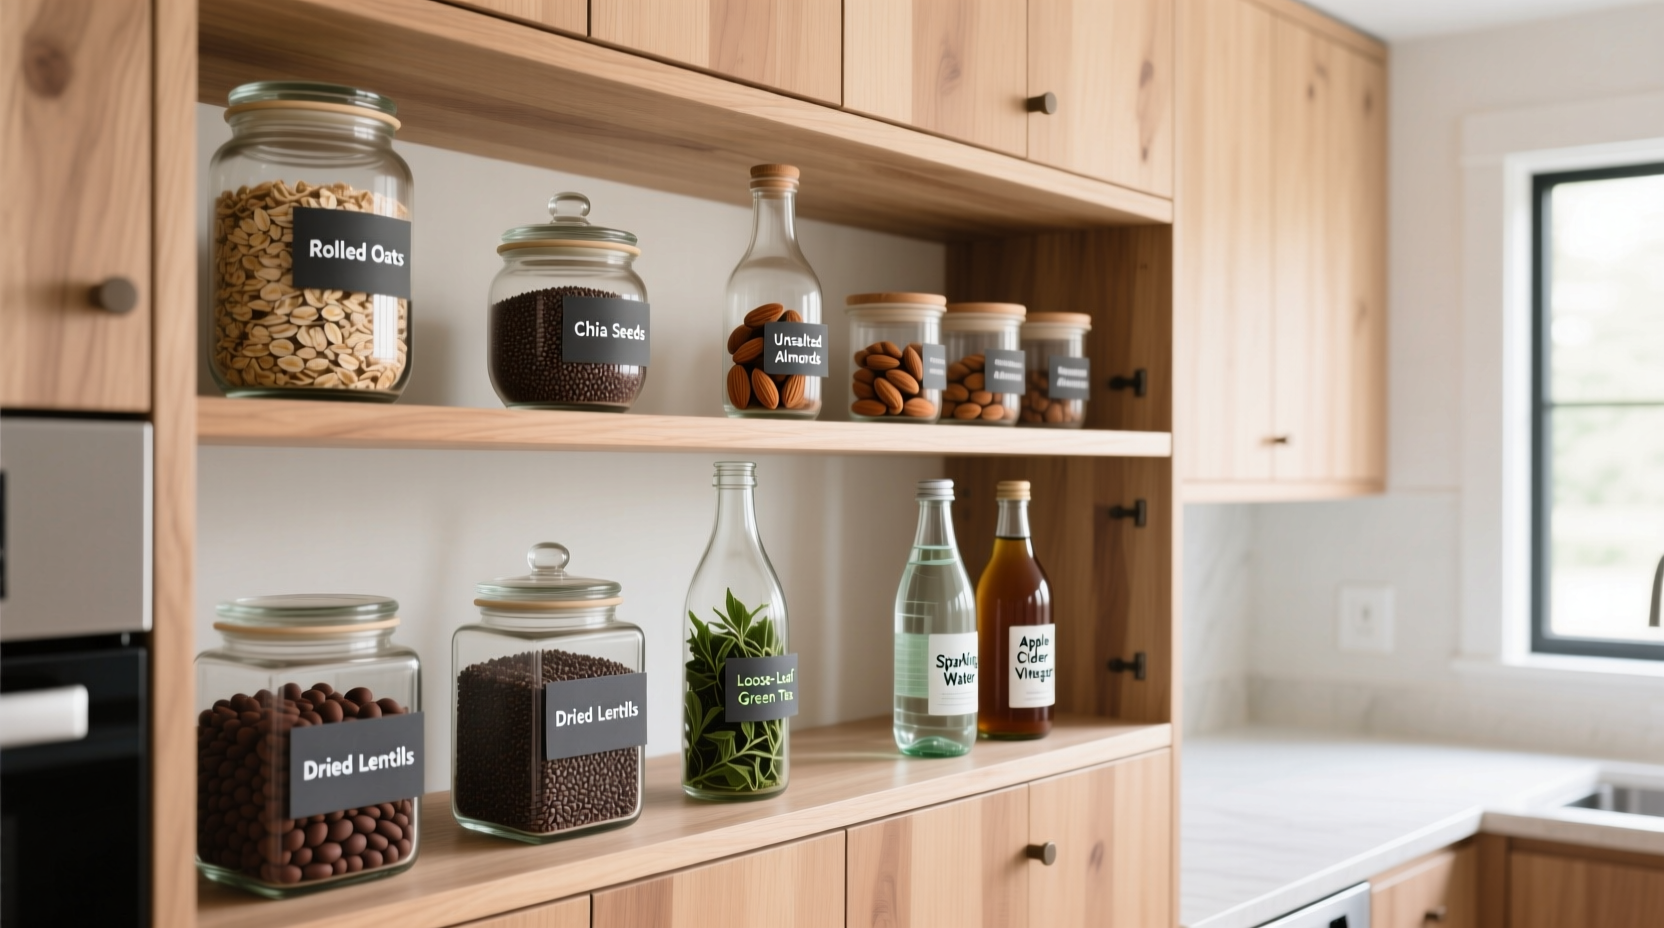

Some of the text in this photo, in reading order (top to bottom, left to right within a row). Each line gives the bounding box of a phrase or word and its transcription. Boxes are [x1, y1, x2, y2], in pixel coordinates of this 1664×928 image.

[310, 239, 404, 266] Rolled Oats
[574, 320, 645, 340] Chia Seeds
[1019, 633, 1049, 652] Apple
[943, 671, 975, 686] Water
[738, 691, 776, 705] Green
[556, 705, 593, 727] Dried
[303, 745, 415, 781] Dried Lentils
